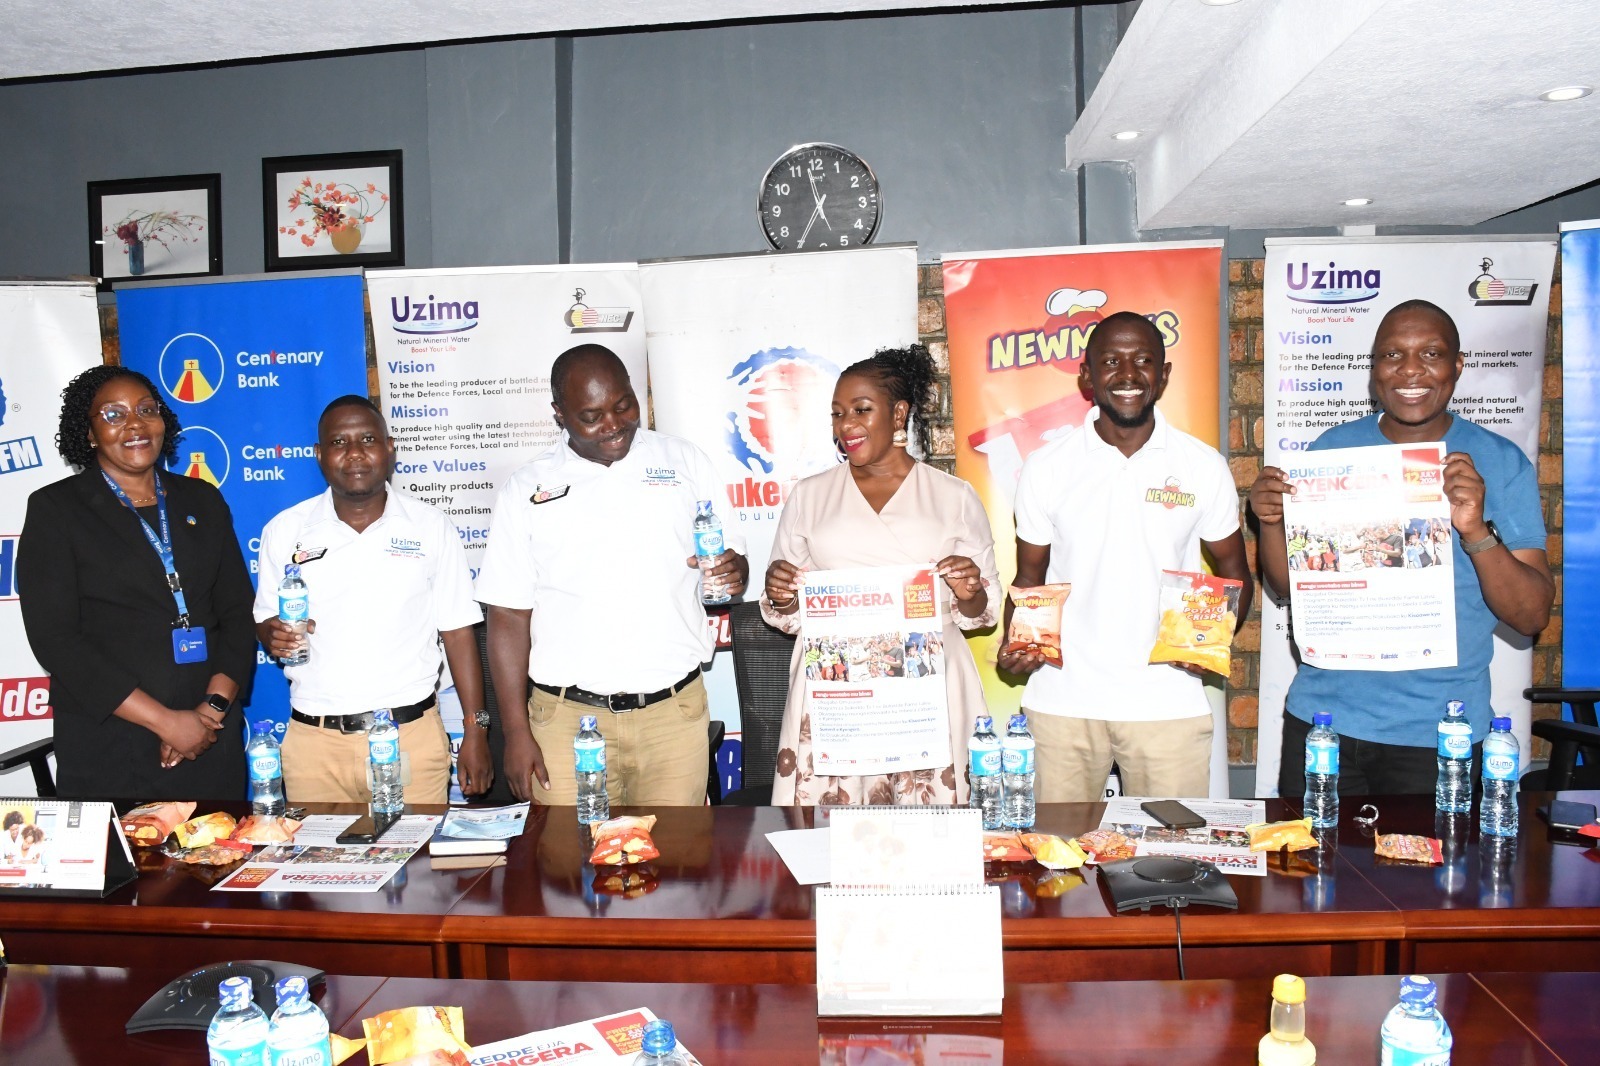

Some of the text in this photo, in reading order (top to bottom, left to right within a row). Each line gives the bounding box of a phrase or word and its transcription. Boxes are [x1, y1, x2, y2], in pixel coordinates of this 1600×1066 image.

[808, 159, 823, 171] 12
[834, 161, 840, 173] 1
[789, 165, 802, 178] 11
[850, 176, 859, 188] 2
[774, 183, 790, 196] 10
[858, 196, 867, 208] 3
[772, 205, 781, 217] 9
[853, 219, 864, 230] 4
[780, 226, 789, 238] 8
[840, 235, 849, 246] 5
[1286, 261, 1381, 291] Uzima
[1507, 286, 1525, 296] NEC
[391, 294, 479, 322] Uzima
[1307, 316, 1326, 324] Boost
[397, 336, 470, 346] Natural Mineral Water
[1278, 330, 1332, 344] Vision
[236, 349, 324, 368] Centenary
[1322, 353, 1354, 362] leading
[1474, 350, 1509, 358] mineral
[1510, 350, 1533, 358] water
[388, 360, 436, 374] Vision
[1279, 364, 1292, 372] for
[1482, 360, 1518, 368] markets.
[238, 372, 280, 388] Bank
[426, 380, 458, 389] leading
[460, 378, 497, 388] producer
[499, 377, 508, 386] of
[1278, 378, 1343, 392] Mission
[390, 392, 401, 400] for
[402, 390, 416, 399] the
[417, 389, 450, 398] Defence
[452, 388, 480, 397] Forces,
[482, 388, 504, 396] Local
[506, 387, 522, 395] and
[1290, 400, 1325, 408] produce
[1327, 399, 1346, 408] high
[1348, 398, 1378, 408] quality
[1452, 396, 1518, 404] bottled natural
[391, 404, 449, 419] Mission
[1277, 410, 1312, 418] mineral
[1340, 410, 1364, 418] using
[1495, 406, 1524, 414] benefit
[400, 425, 432, 434] produce
[434, 424, 453, 433] high
[456, 422, 484, 432] quality
[486, 422, 501, 430] and
[504, 420, 553, 430] dependable
[1305, 420, 1340, 428] Defence
[448, 433, 470, 442] using
[472, 432, 486, 440] the
[488, 432, 510, 440] latest
[415, 443, 448, 452] Defence
[450, 442, 478, 450] Forces,
[480, 442, 501, 450] Local
[502, 441, 520, 449] and
[394, 458, 487, 474] Core Values
[646, 466, 676, 476] Uzima
[243, 466, 286, 482] Bank
[1404, 472, 1420, 484] 12
[410, 480, 494, 494] Quality products
[1146, 488, 1196, 508] NEWMAN'S
[391, 537, 422, 548] Uzima
[804, 584, 862, 596] BUKEDDE
[806, 592, 894, 609] KYENGERA
[904, 591, 918, 603] 12
[1489, 758, 1514, 769] Uzima
[281, 874, 384, 882] KYENGERA
[606, 1032, 630, 1044] 12
[536, 1040, 565, 1050] EJJA
